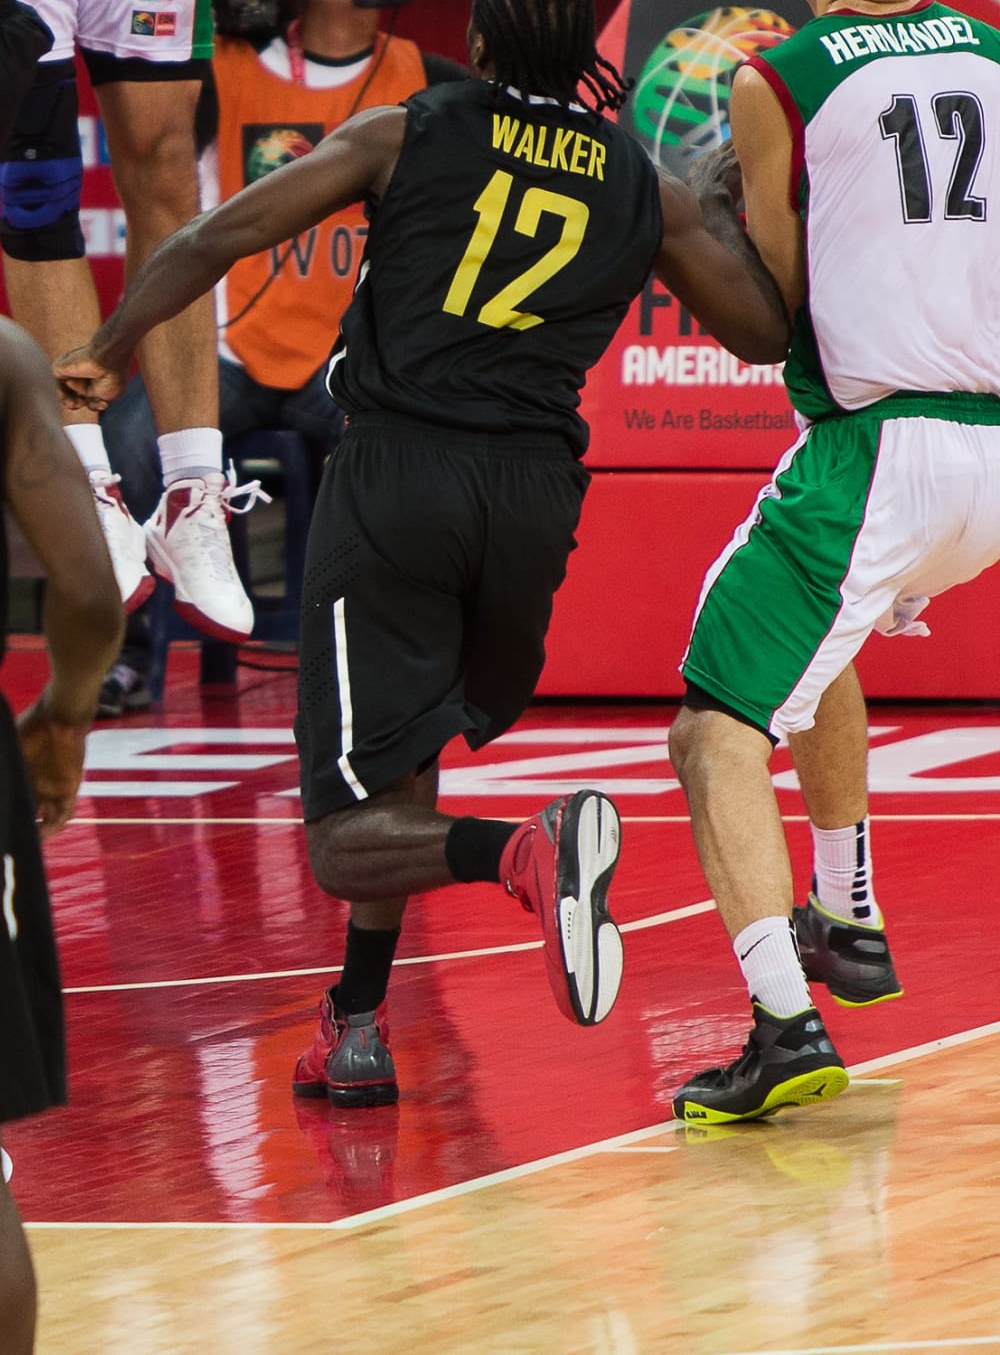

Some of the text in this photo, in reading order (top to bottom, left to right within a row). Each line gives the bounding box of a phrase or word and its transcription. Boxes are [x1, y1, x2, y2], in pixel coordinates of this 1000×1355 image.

[819, 16, 981, 65] HERNANDEZ
[492, 113, 606, 182] WALKER
[878, 90, 987, 224] 12
[442, 169, 590, 331] 12
[624, 409, 656, 430] We
[661, 409, 694, 430] Are
